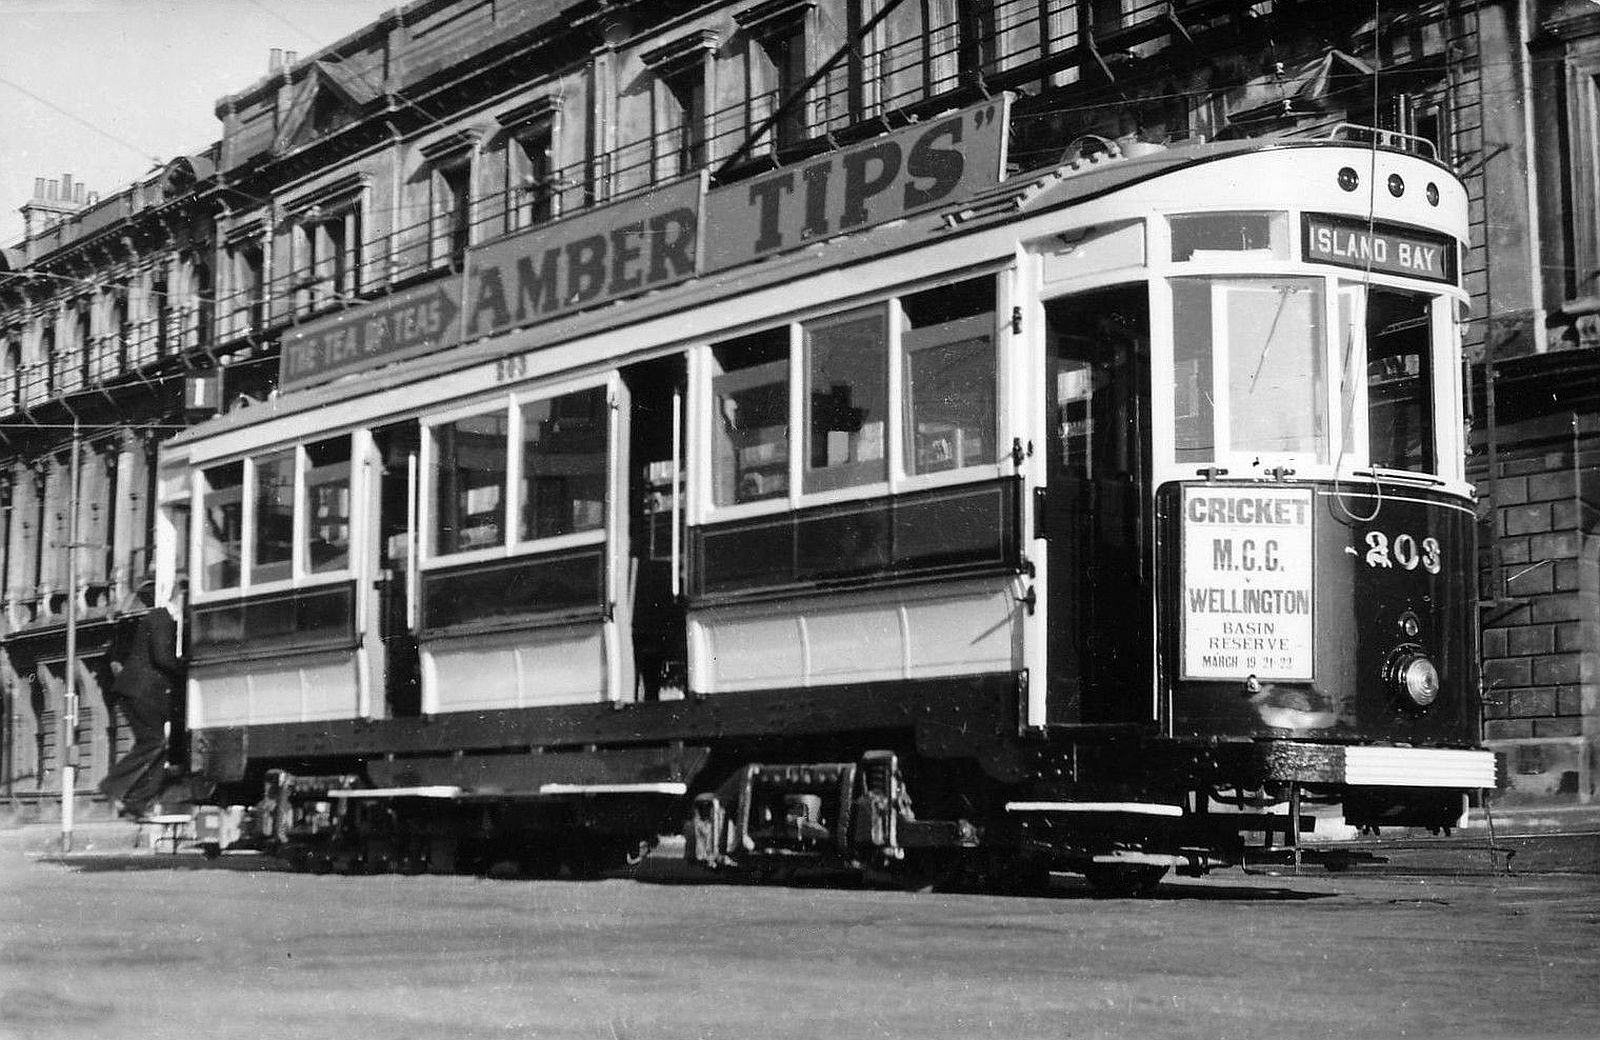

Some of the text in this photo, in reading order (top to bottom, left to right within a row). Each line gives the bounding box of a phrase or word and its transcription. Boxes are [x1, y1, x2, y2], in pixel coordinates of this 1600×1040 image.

[1308, 226, 1435, 272] ISLAND BAY
[323, 326, 359, 364] TEA
[394, 298, 441, 344] TEAS
[1188, 497, 1309, 525] CRICKET
[1213, 538, 1284, 572] M.C.C.
[1365, 531, 1441, 574] 203
[1189, 588, 1309, 615] WELLINGTON
[1222, 622, 1275, 635] BASIN
[1208, 637, 1290, 651] RESERVE
[1202, 655, 1239, 668] MARCH
